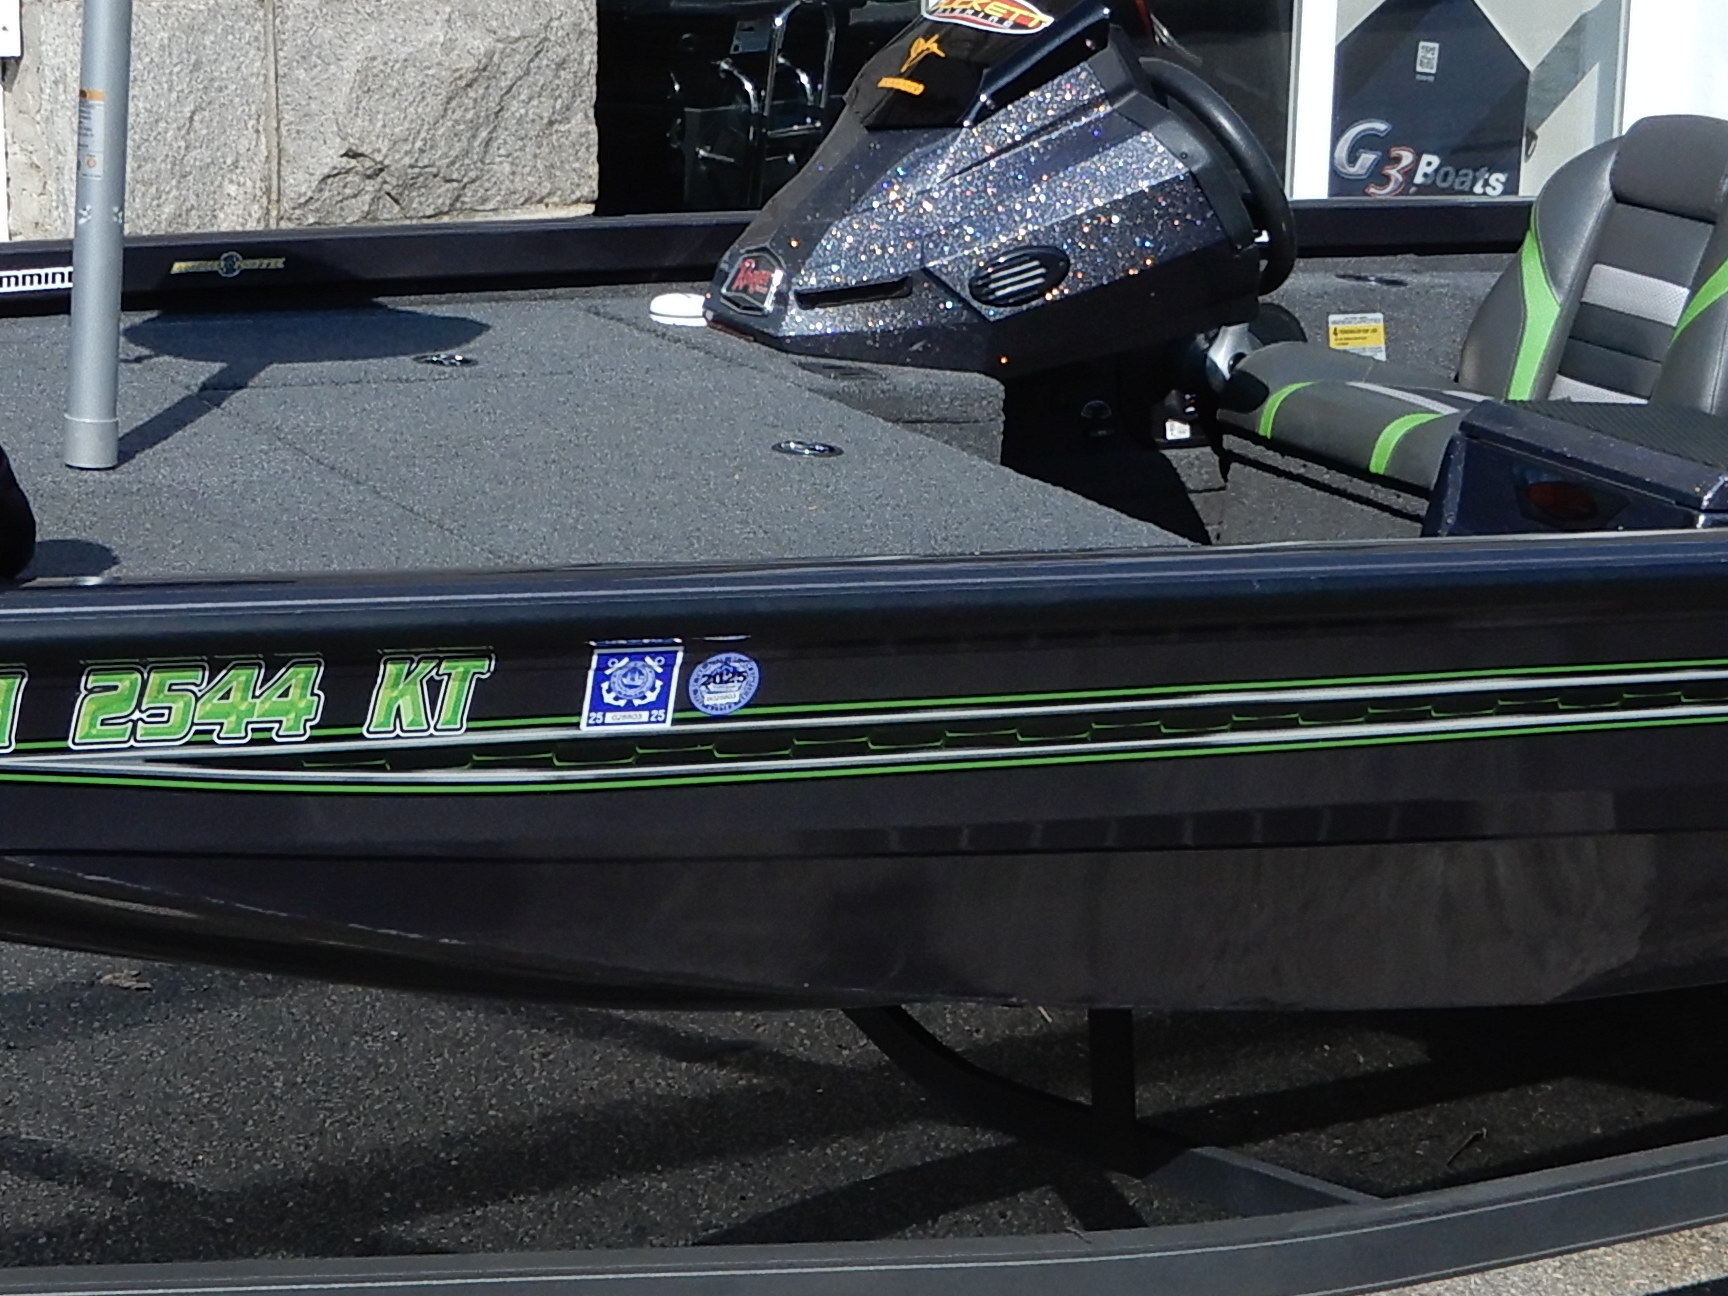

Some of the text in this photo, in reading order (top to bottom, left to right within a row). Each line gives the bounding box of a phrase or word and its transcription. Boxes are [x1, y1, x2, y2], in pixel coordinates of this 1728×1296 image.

[1412, 153, 1509, 197] Boats
[70, 660, 323, 746] 2544
[366, 655, 493, 738] KT
[588, 711, 604, 724] 25
[649, 709, 666, 722] 25
